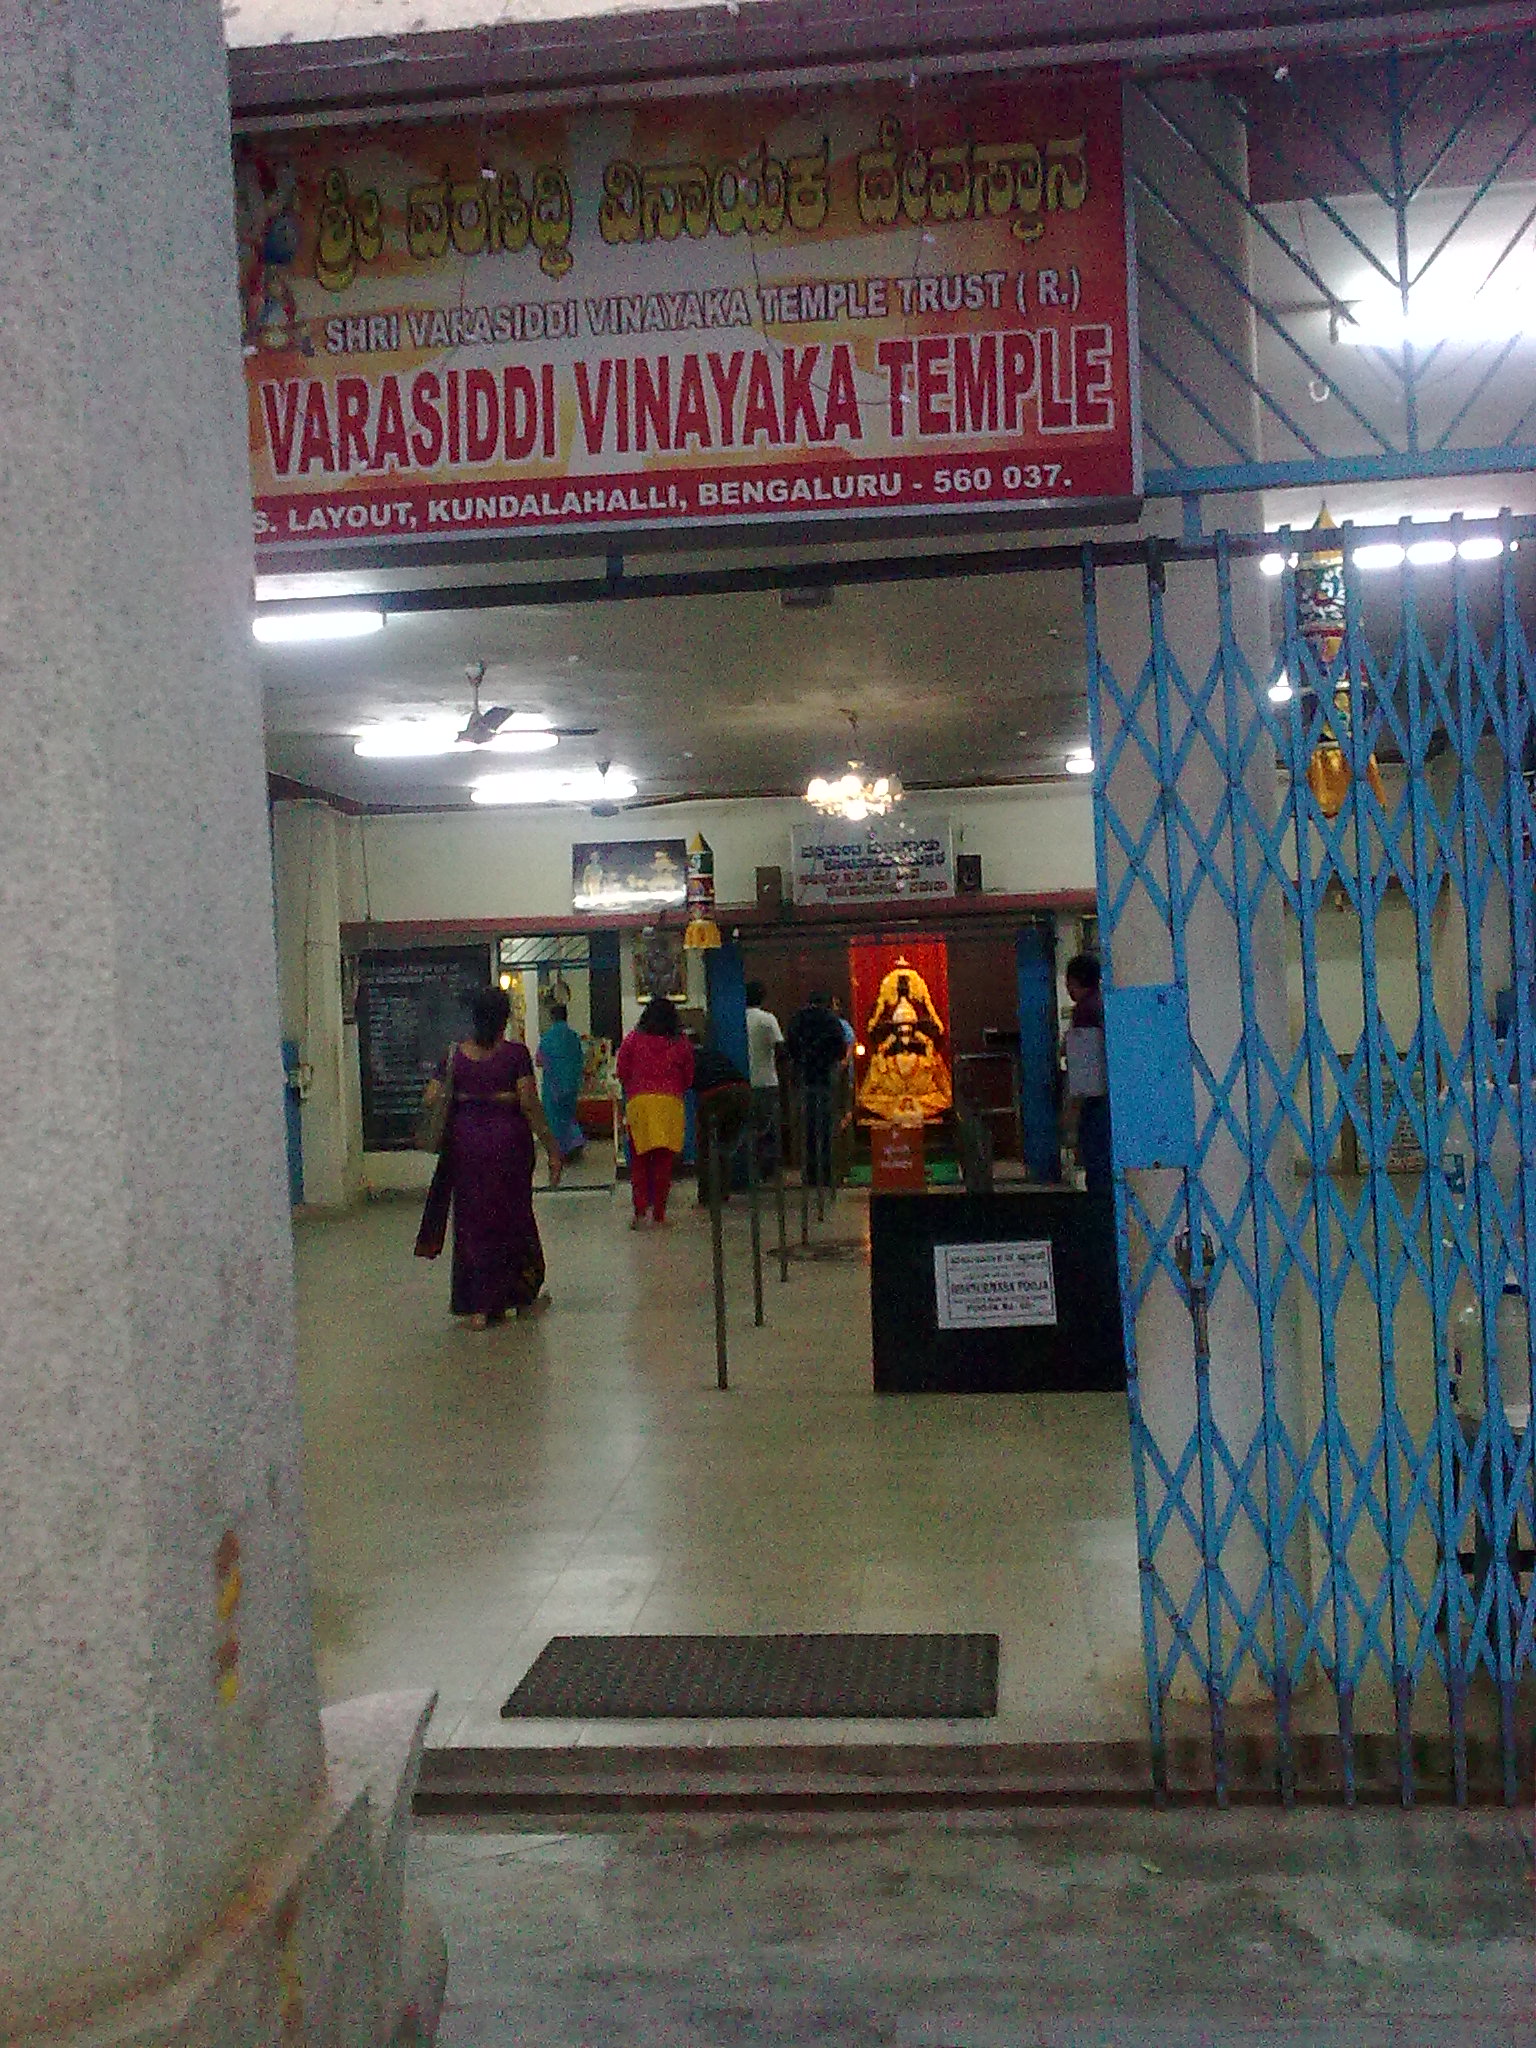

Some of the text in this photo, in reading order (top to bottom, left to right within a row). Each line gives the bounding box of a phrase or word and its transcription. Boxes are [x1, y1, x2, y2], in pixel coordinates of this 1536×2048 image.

[600, 135, 829, 245] ವಿನಾಯಕ
[325, 314, 399, 356] SHRI
[406, 299, 578, 350] VARASIDDI
[585, 287, 752, 337] VINAYAKA
[759, 278, 888, 325] TEMPLE
[895, 270, 1006, 314] TRUST
[260, 325, 1115, 477] VARASIDDI VINAYAKA TEMPLE
[288, 501, 418, 532] LAYOUT,
[428, 485, 688, 524] KUNDALAHALLI,
[699, 473, 902, 508] BENGALURU
[933, 466, 992, 494] 560
[1003, 463, 1073, 492] 037.
